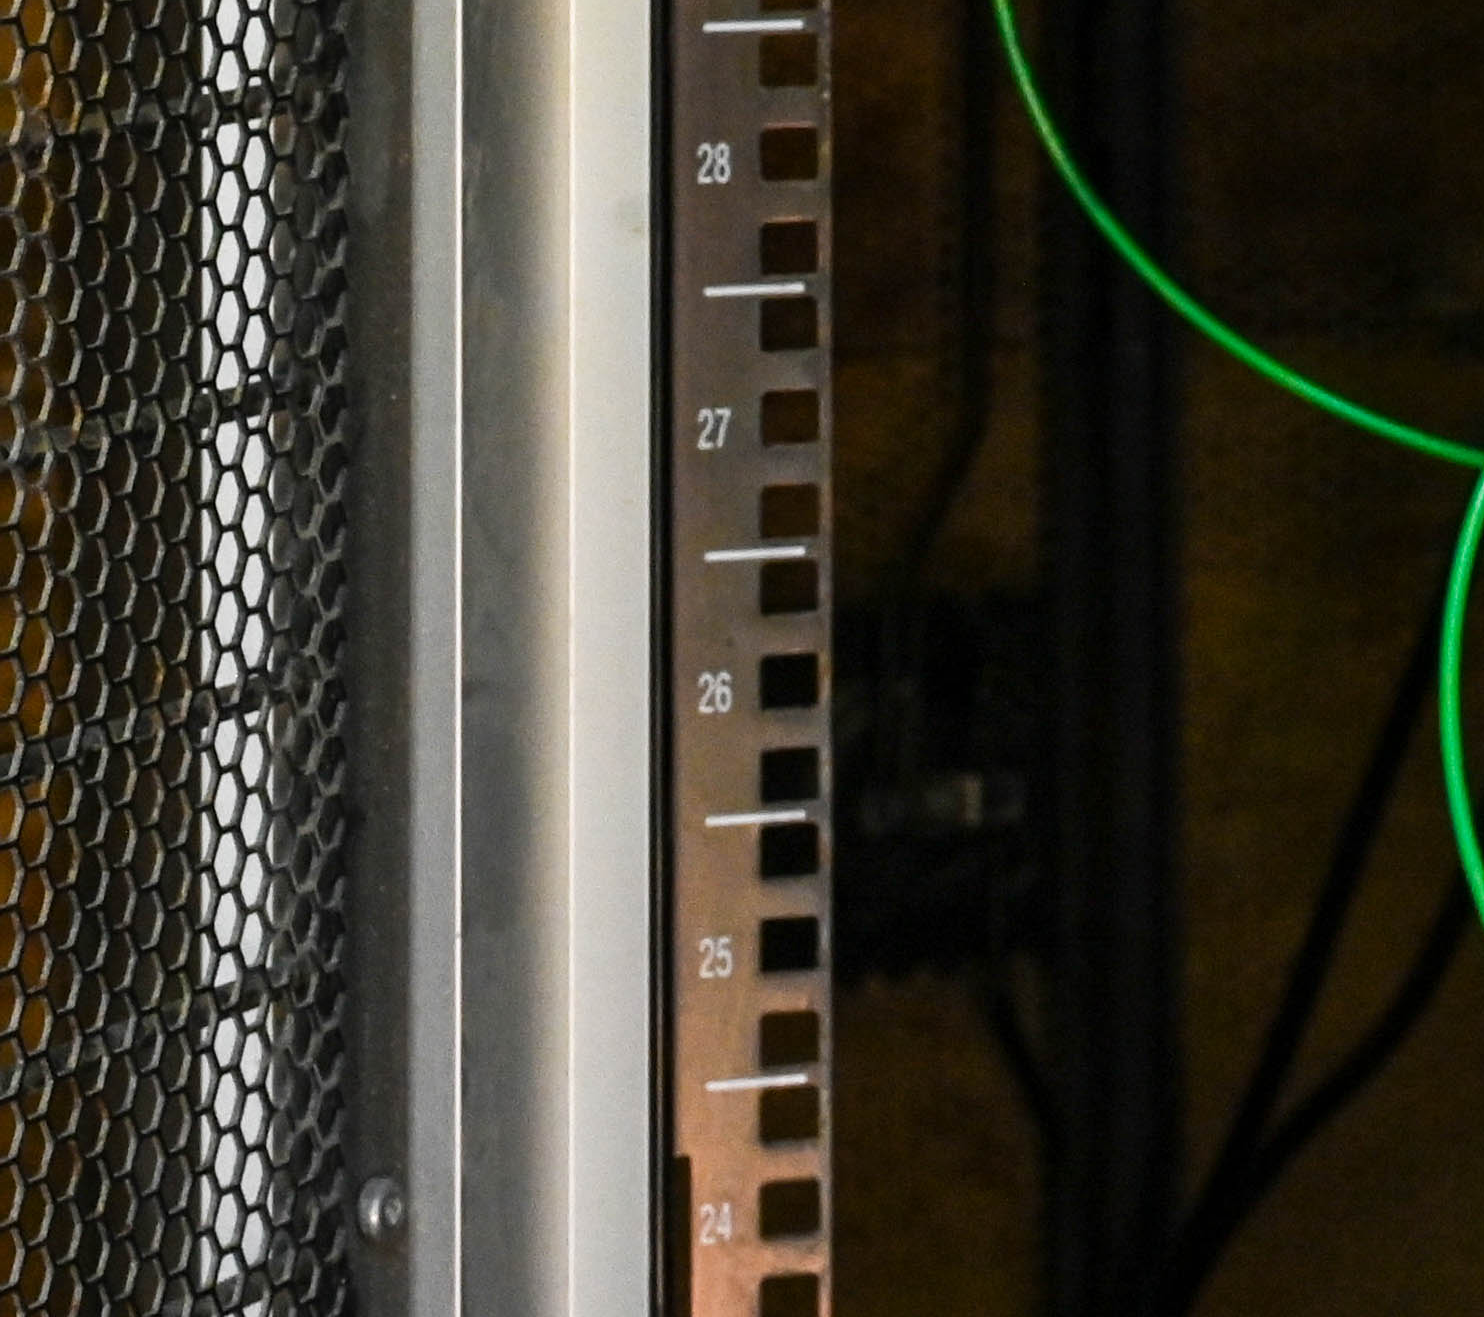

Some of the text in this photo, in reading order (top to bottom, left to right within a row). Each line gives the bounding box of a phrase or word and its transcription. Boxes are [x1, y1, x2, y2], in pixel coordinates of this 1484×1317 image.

[697, 142, 732, 184] 28
[697, 408, 732, 450] 27
[698, 672, 732, 714] 26
[698, 937, 733, 979] 25
[699, 1203, 732, 1246] 24
